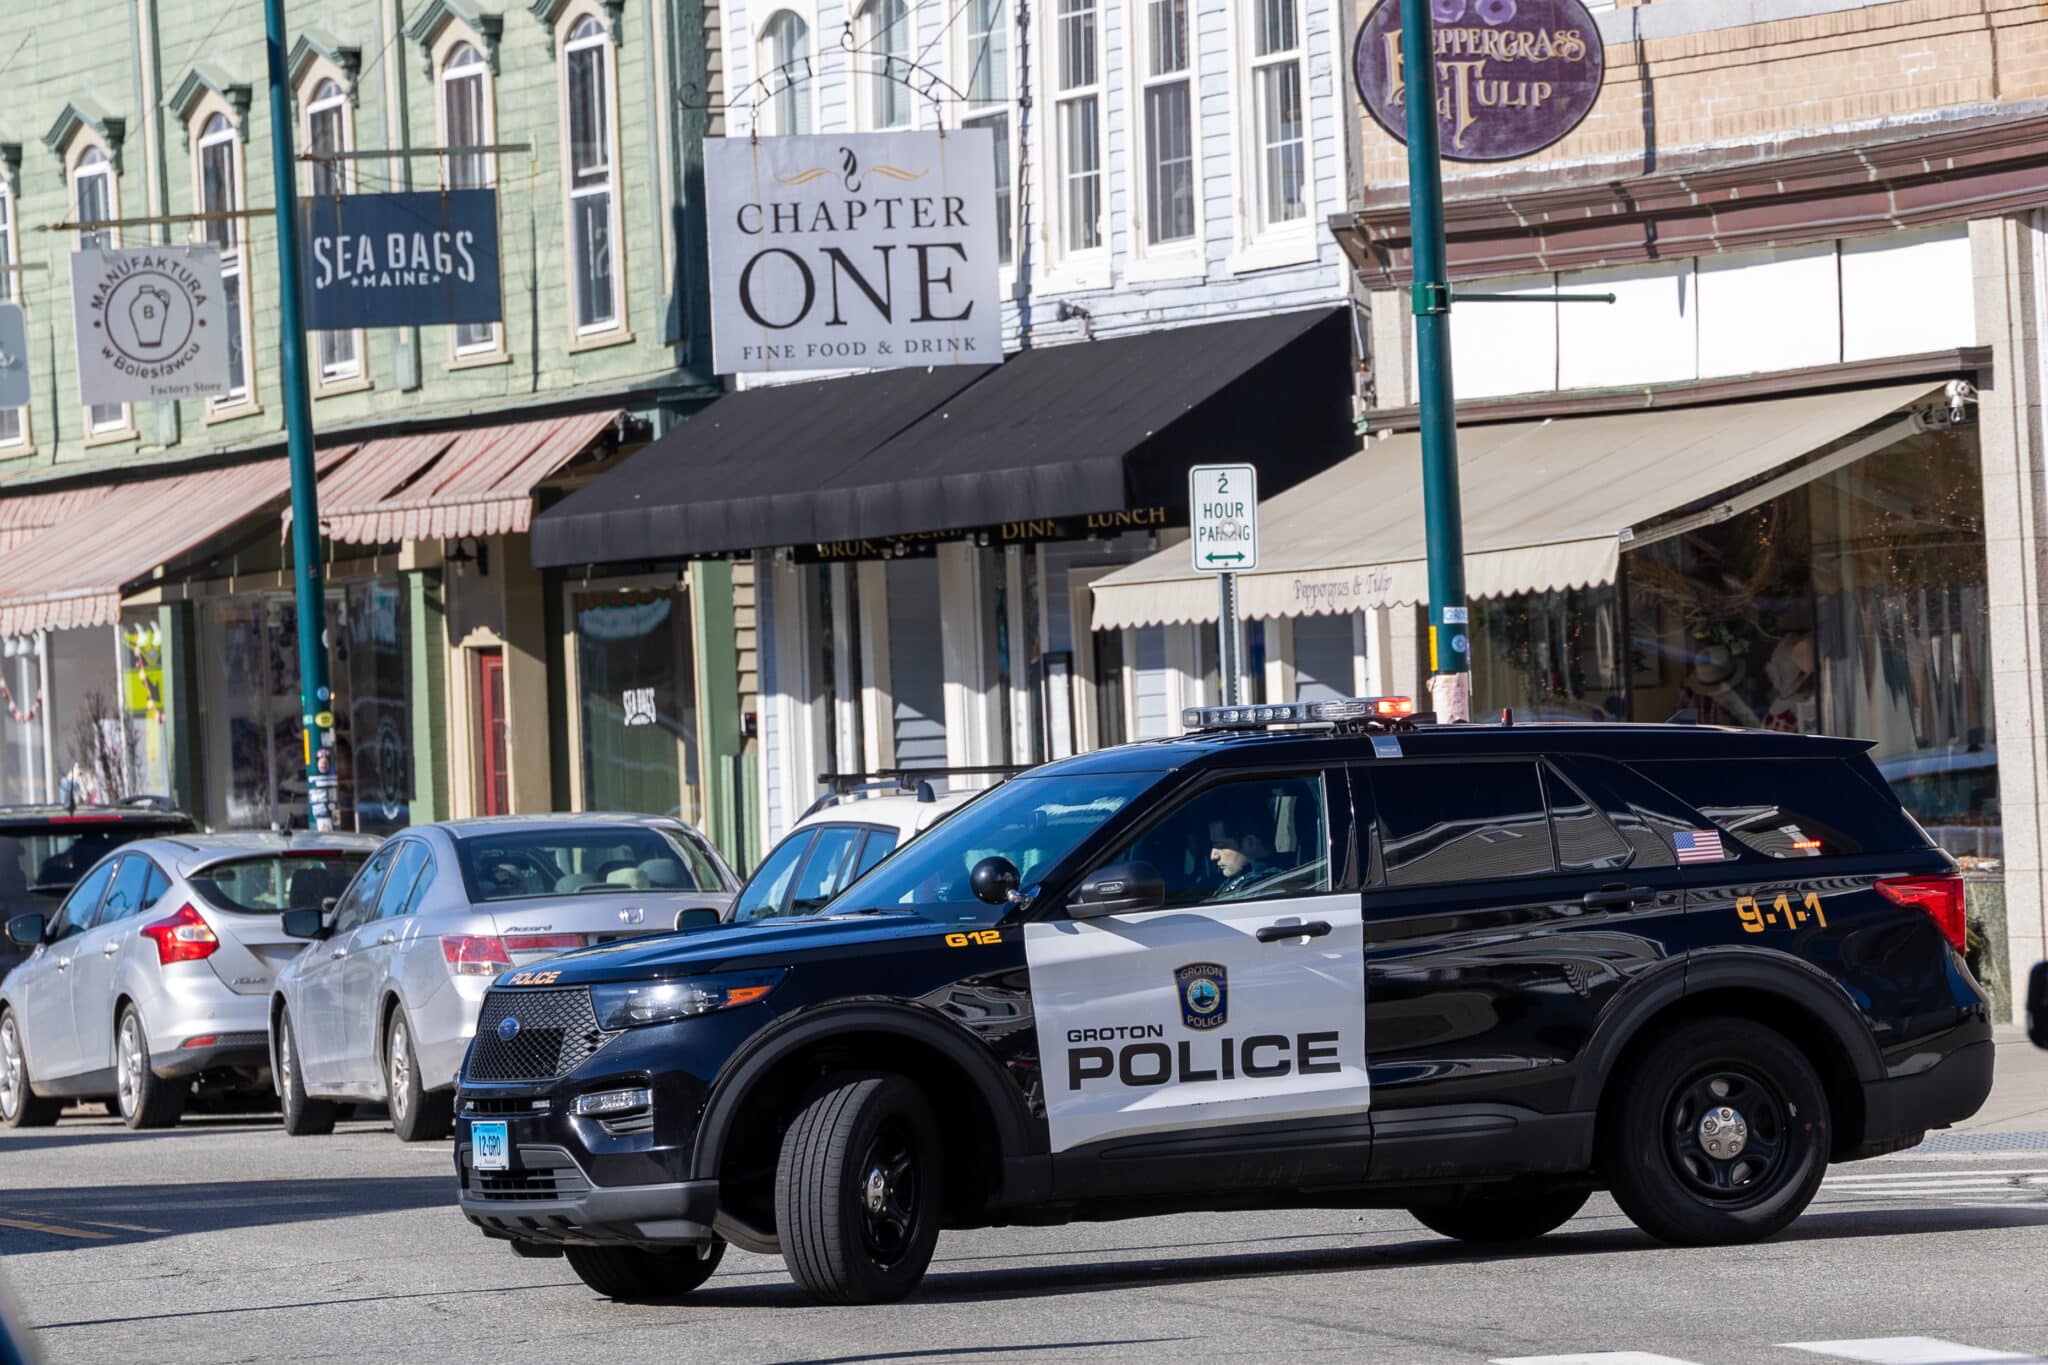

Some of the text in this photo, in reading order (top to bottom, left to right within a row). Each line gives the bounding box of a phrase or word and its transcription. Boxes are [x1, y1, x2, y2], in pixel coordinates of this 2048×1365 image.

[1436, 59, 1553, 150] TULIP
[736, 196, 970, 235] CHAPTER
[313, 230, 476, 290] SEA BAGS
[90, 254, 208, 311] MANUFAKTURA
[362, 270, 430, 289] MAINE
[738, 241, 975, 330] ONE
[143, 304, 155, 320] B
[742, 335, 978, 361] FINE FOOD & DRINK
[150, 380, 222, 397] Factory Store
[1217, 477, 1230, 495] 2
[1087, 506, 1167, 528] LUNCH
[1203, 501, 1245, 520] HOUR
[1199, 525, 1250, 543] PARG
[944, 929, 1003, 948] G12
[507, 970, 562, 985] POLICE
[1180, 966, 1223, 979] GROTON
[1187, 1013, 1223, 1028] POLICE
[1066, 1024, 1164, 1042] GROTON
[1067, 1030, 1342, 1091] POLICE
